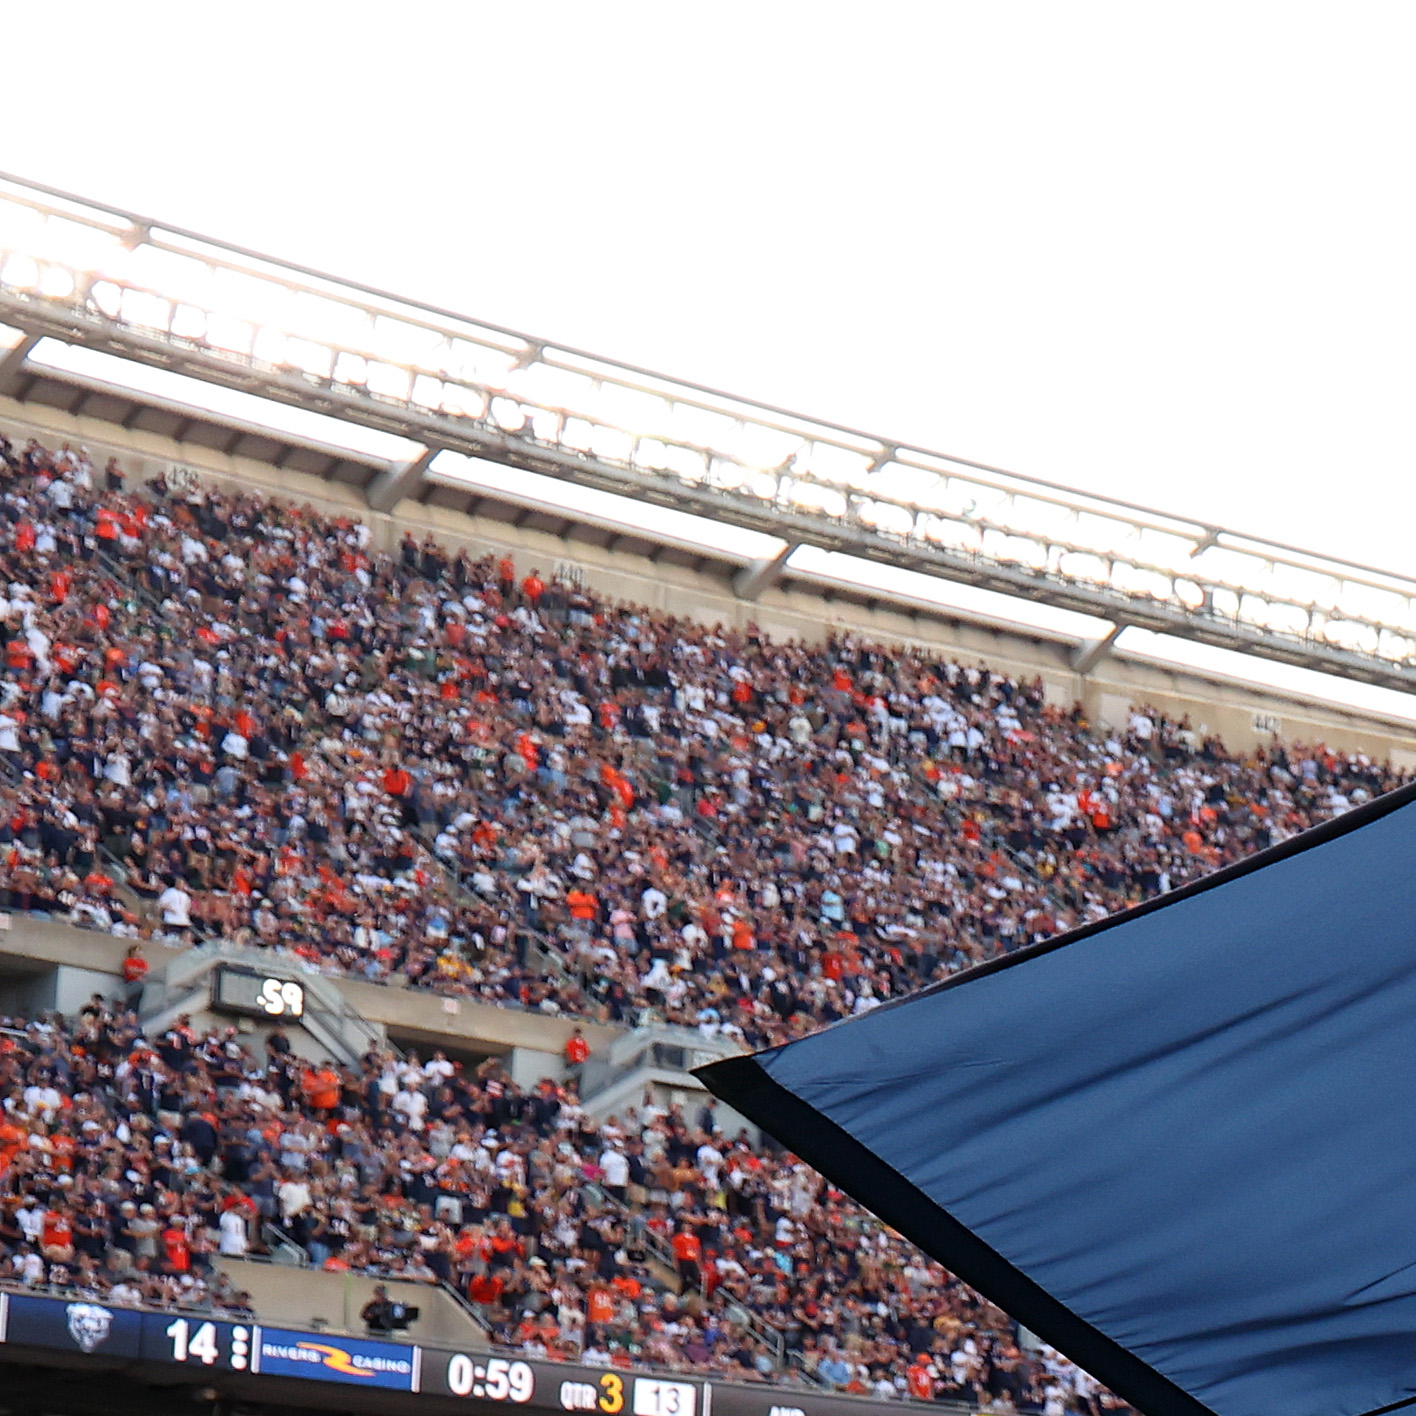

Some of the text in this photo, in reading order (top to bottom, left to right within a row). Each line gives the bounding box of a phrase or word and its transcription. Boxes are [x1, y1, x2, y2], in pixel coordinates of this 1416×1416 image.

[166, 1319, 219, 1364] 14
[262, 1344, 411, 1374] RIVERS CASINO
[448, 1354, 535, 1403] 0:59
[560, 1373, 624, 1414] QTR 3
[650, 1384, 681, 1415] 13
